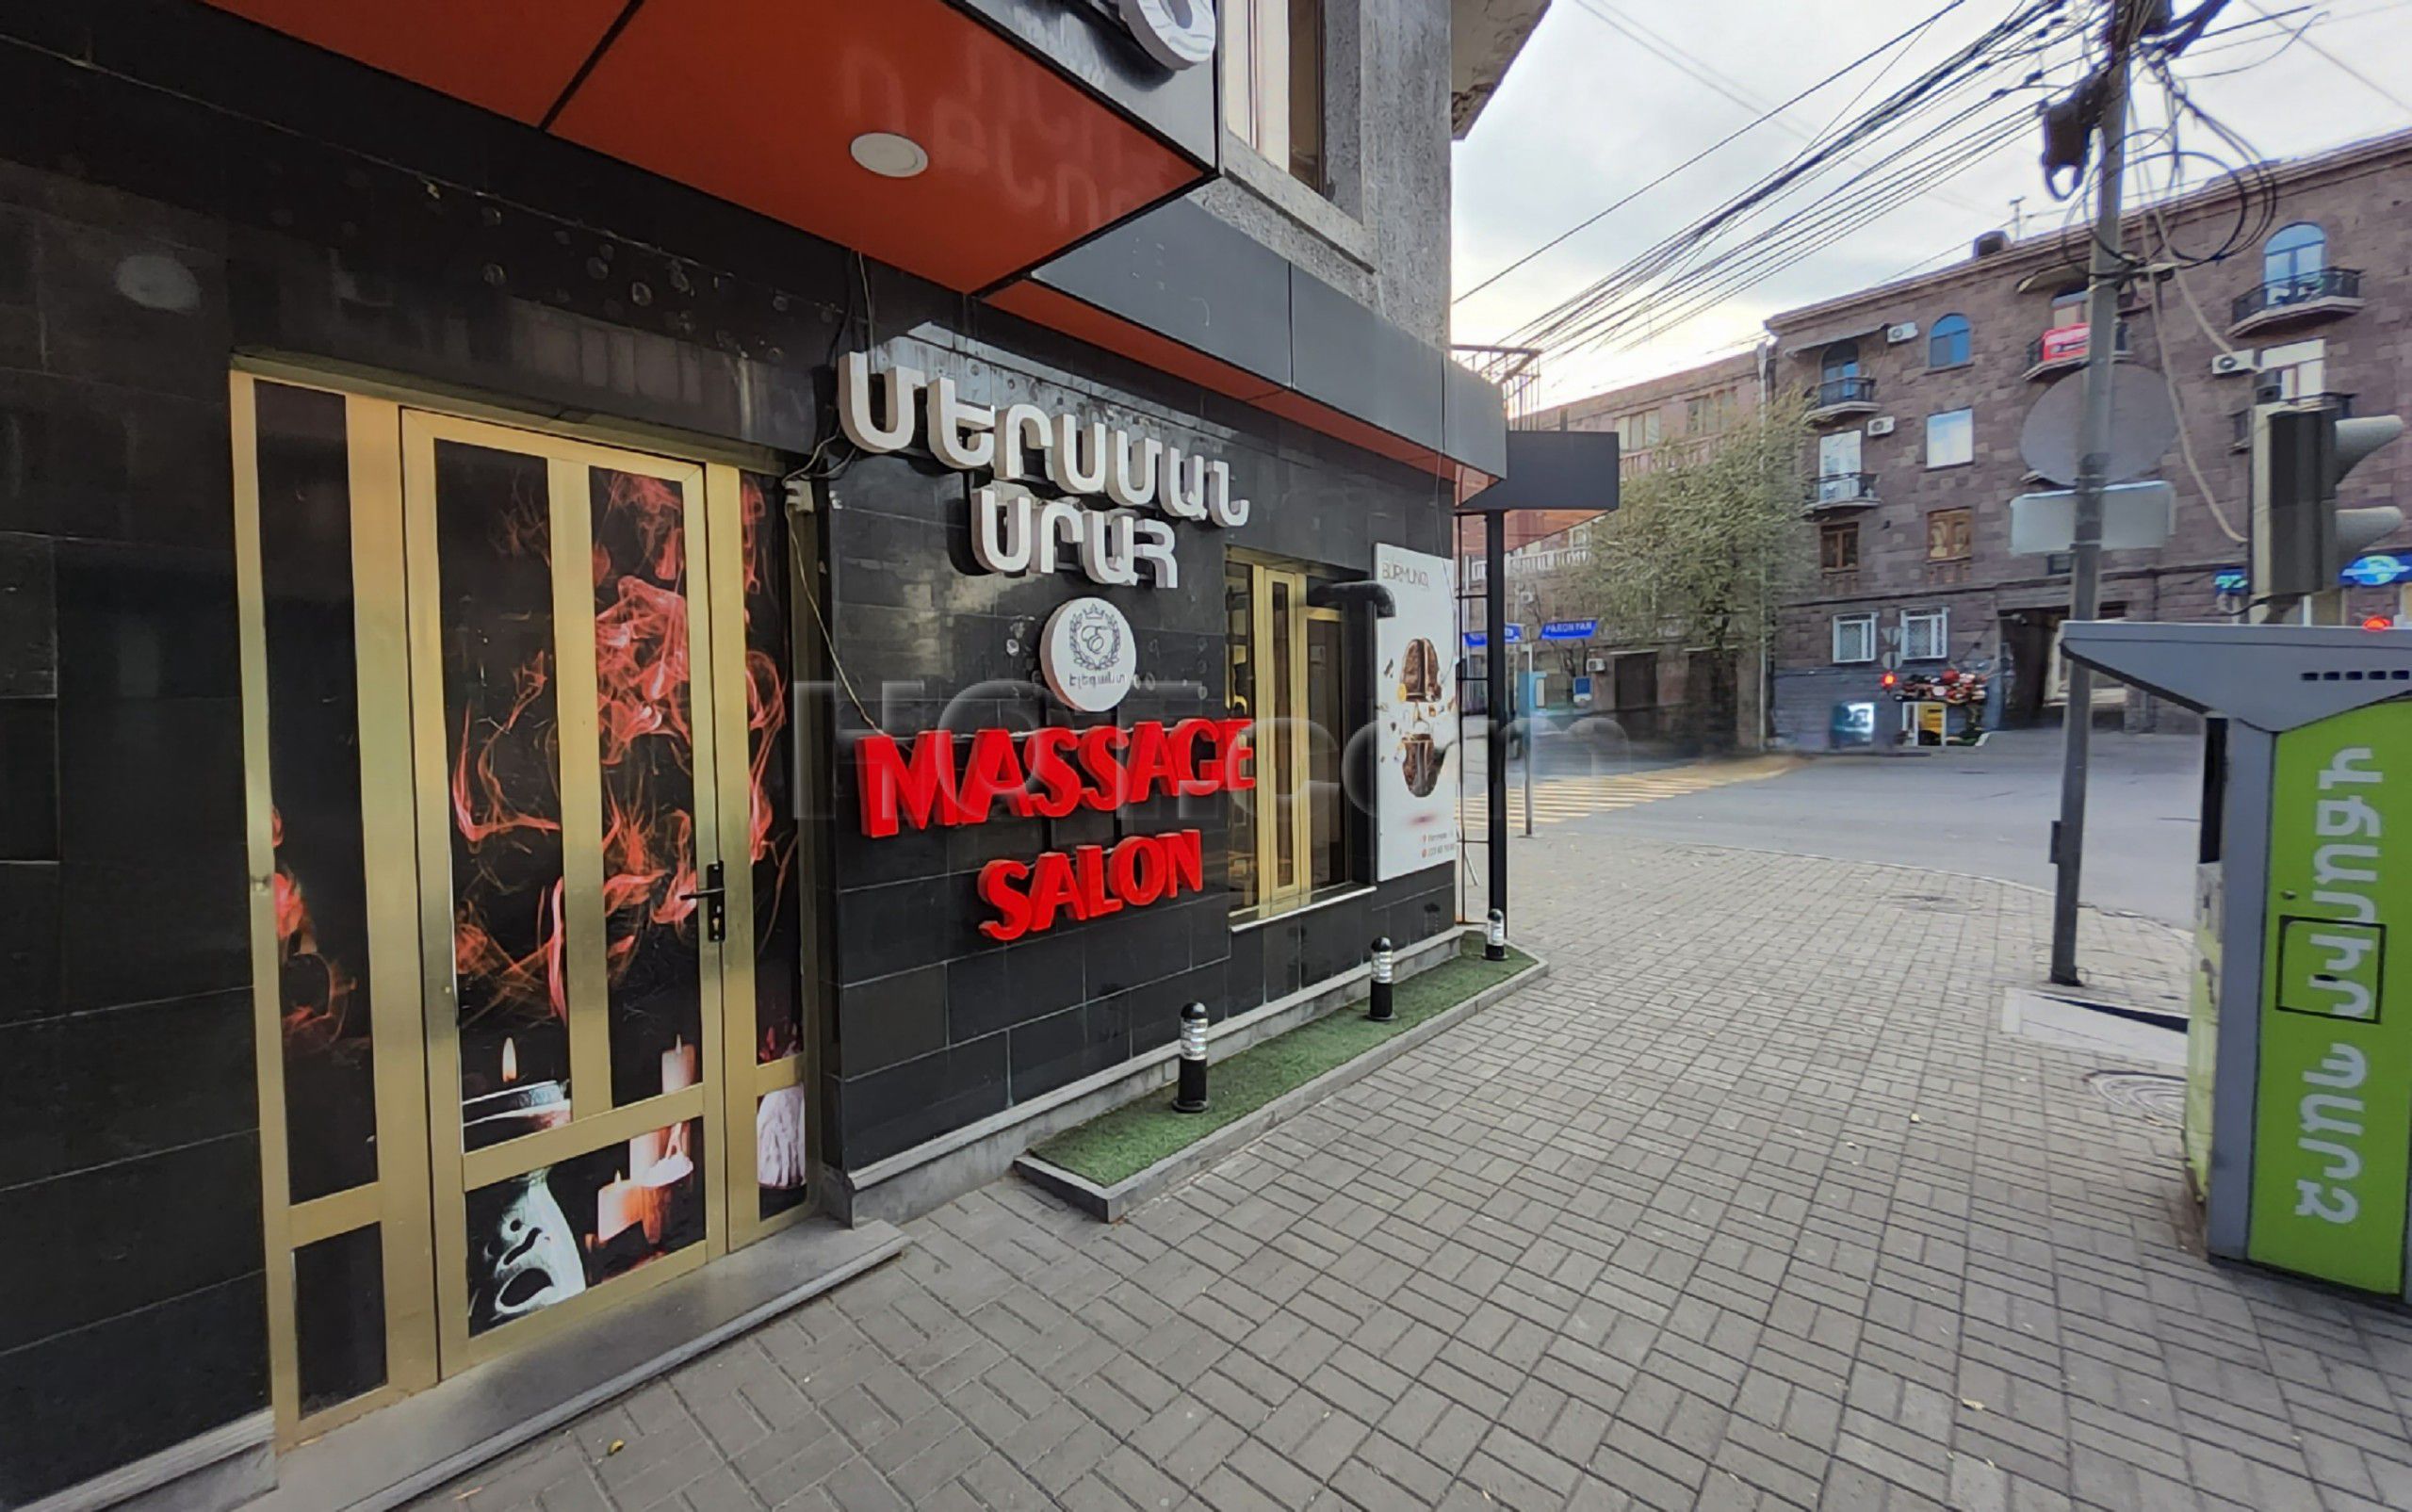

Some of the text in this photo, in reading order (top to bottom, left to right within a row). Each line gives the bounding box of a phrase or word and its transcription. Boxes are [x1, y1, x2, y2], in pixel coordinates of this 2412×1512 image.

[839, 350, 1250, 528] ՄԵՐՍՄԱՆ
[972, 487, 1178, 589] ՍՐԱՀ
[855, 718, 1257, 838] MASSAGE
[977, 829, 1203, 941] SALON
[2294, 747, 2384, 1225] ՎՃԱՐԻՐ ՊԱՐԶ
